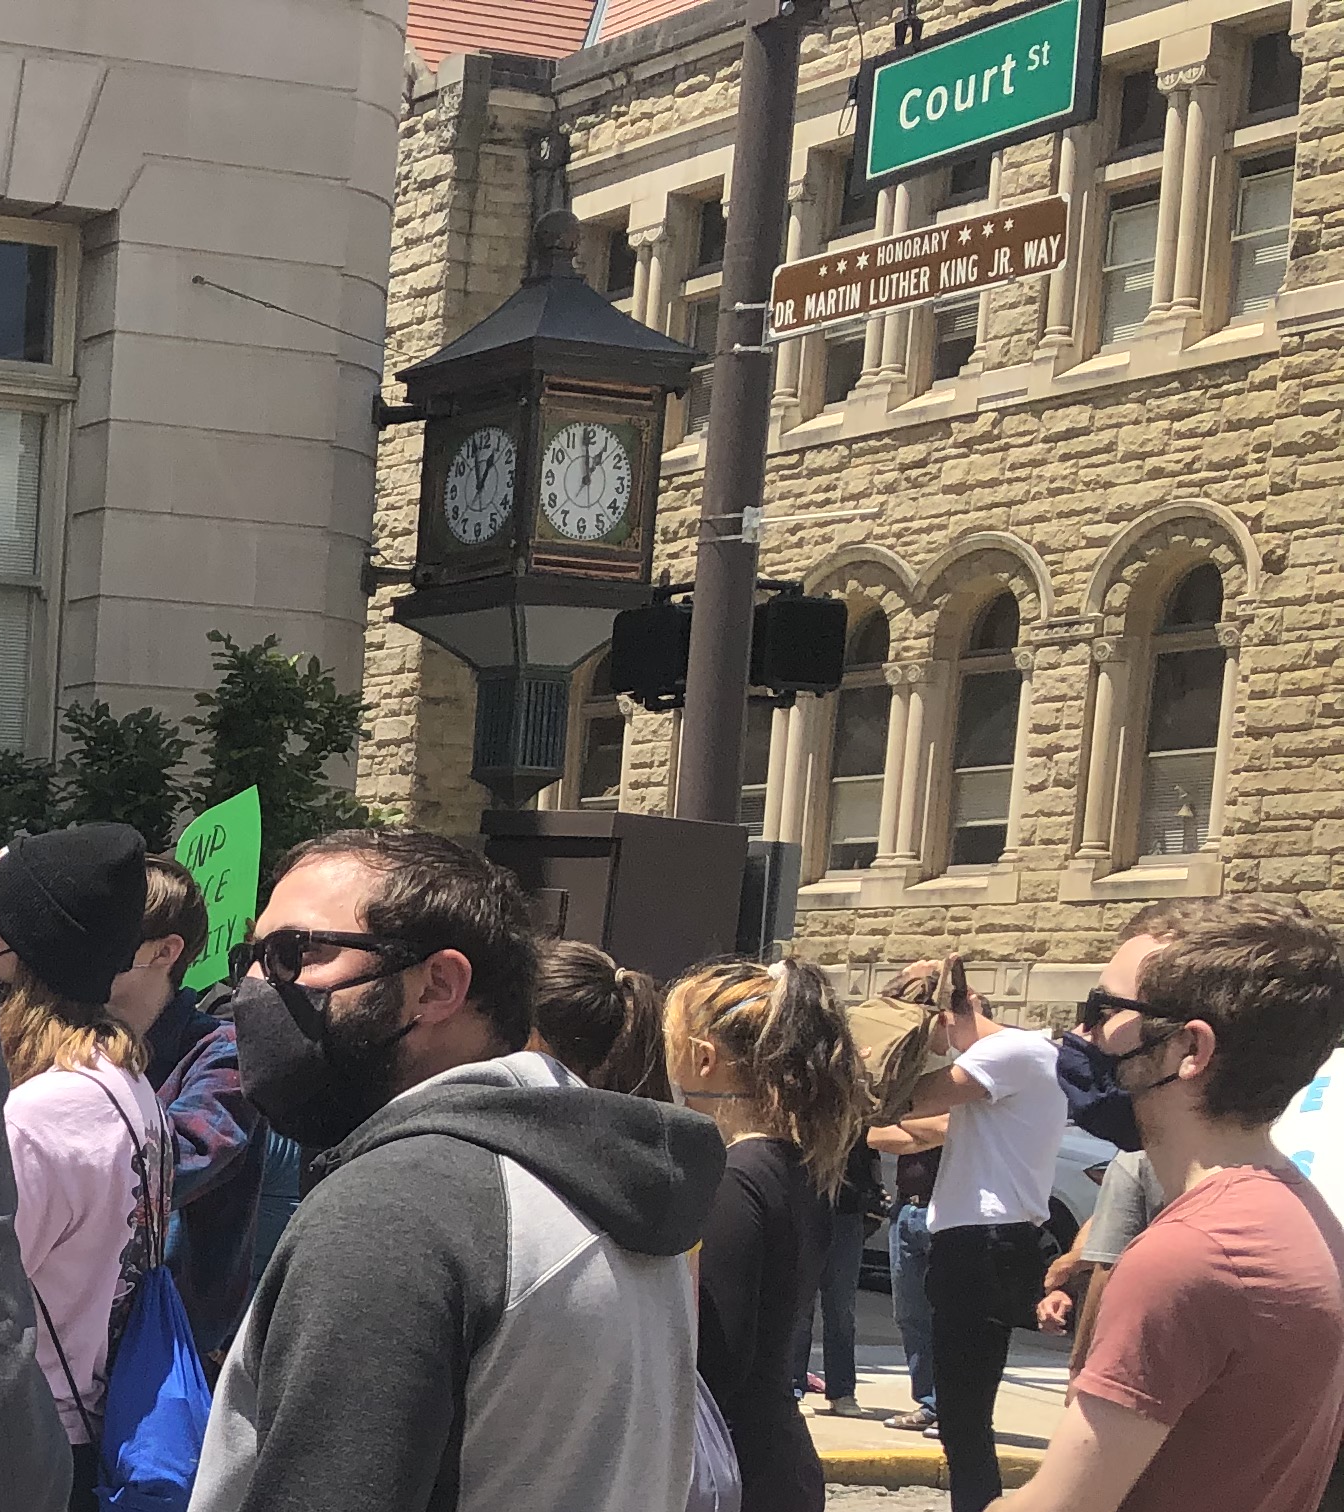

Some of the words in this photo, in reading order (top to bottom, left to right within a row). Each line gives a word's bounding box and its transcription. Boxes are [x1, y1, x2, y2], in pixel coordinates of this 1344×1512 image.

[899, 53, 1017, 130] Court
[1027, 40, 1051, 71] St
[774, 299, 798, 328] DR.
[804, 282, 862, 319] MARTIN
[869, 266, 930, 305] LUTHER
[939, 254, 979, 288] KING
[987, 247, 1014, 278] JR.
[1024, 234, 1062, 269] WAY
[877, 229, 950, 267] HONORARY
[186, 824, 227, 871] END
